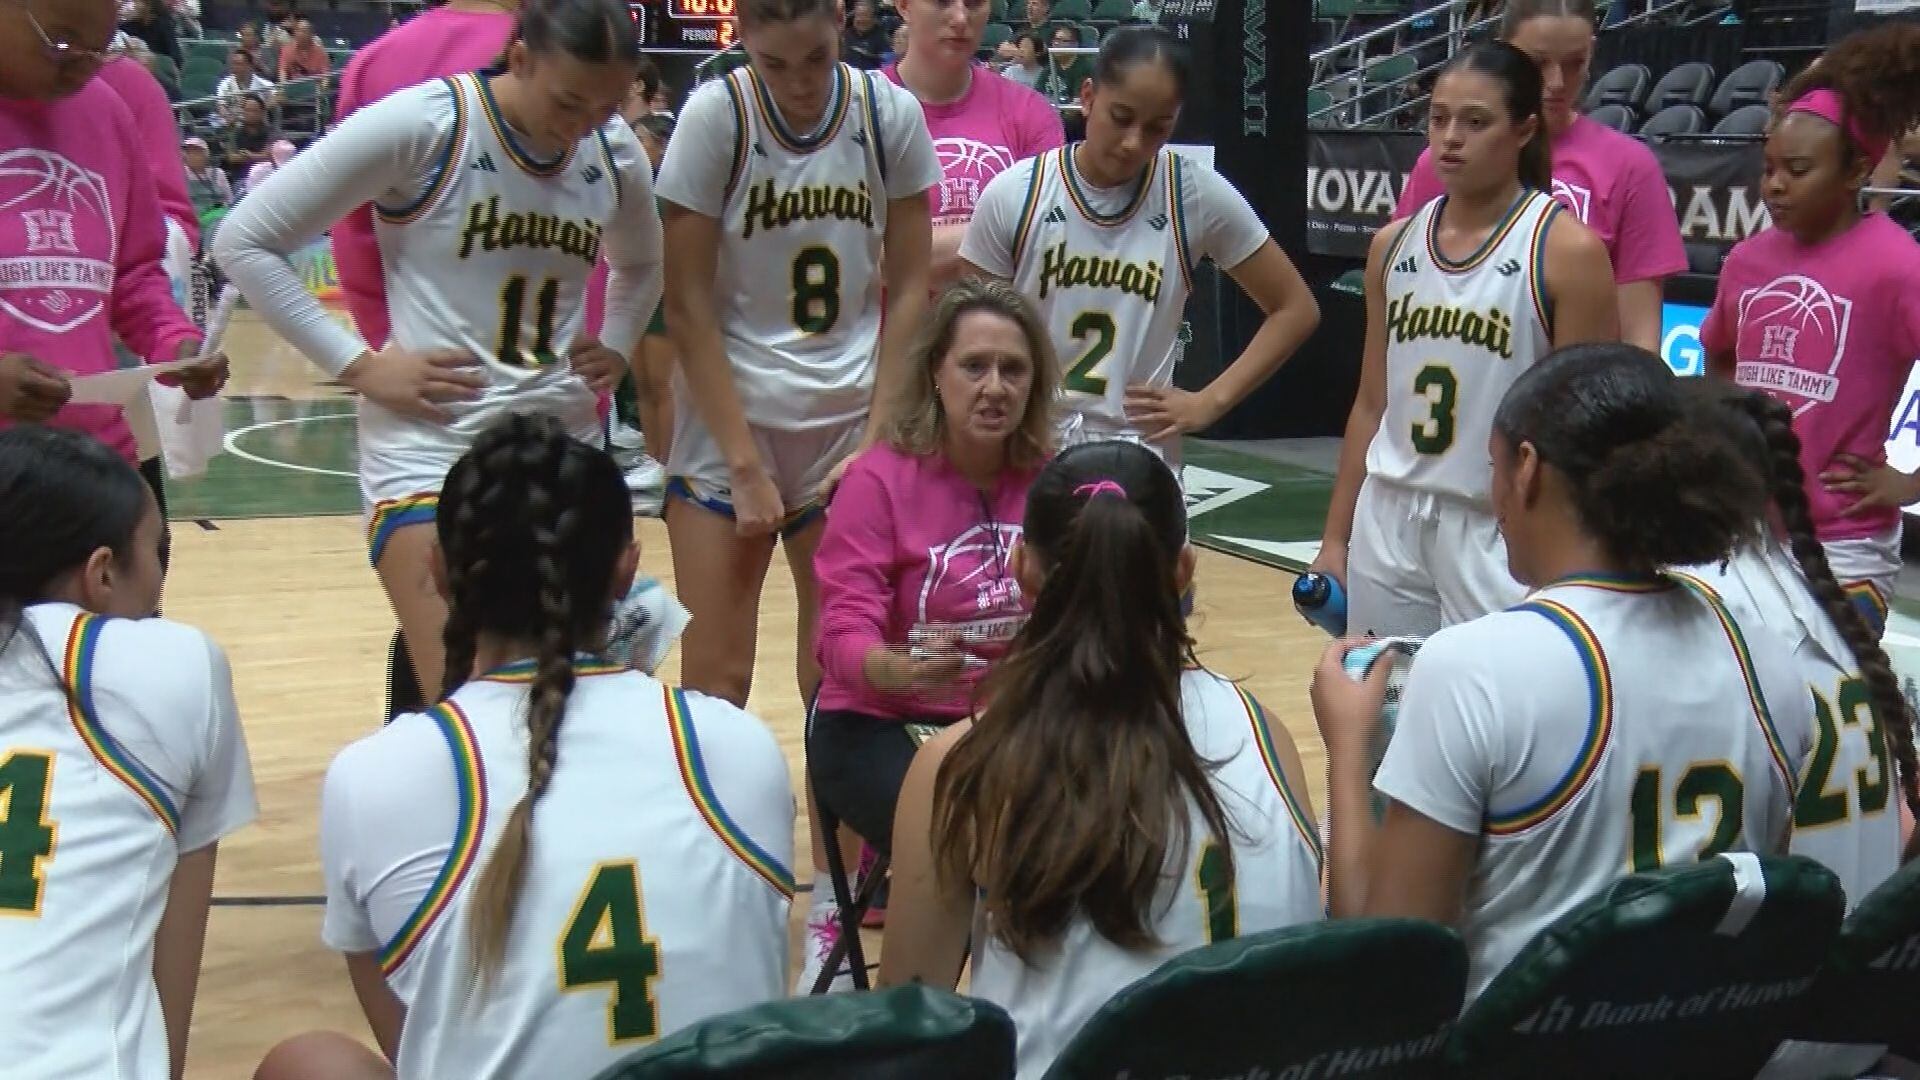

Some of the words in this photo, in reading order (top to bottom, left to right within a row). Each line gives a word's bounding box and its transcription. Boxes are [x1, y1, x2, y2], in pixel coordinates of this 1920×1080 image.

[681, 27, 718, 41] PERIOD
[458, 195, 602, 268] Hawaii
[742, 178, 874, 239] Hawaii
[35, 261, 70, 281] LIKE
[792, 246, 840, 334] 8
[1039, 240, 1164, 306] Hawaii
[495, 272, 562, 366] 11
[1064, 311, 1117, 396] 2
[1386, 292, 1513, 358] Hawaii
[1410, 363, 1459, 456] 3
[1760, 367, 1786, 386] LIKE
[1787, 371, 1833, 397] TAMMY
[1792, 676, 1892, 829] 23
[558, 858, 663, 1044] 4
